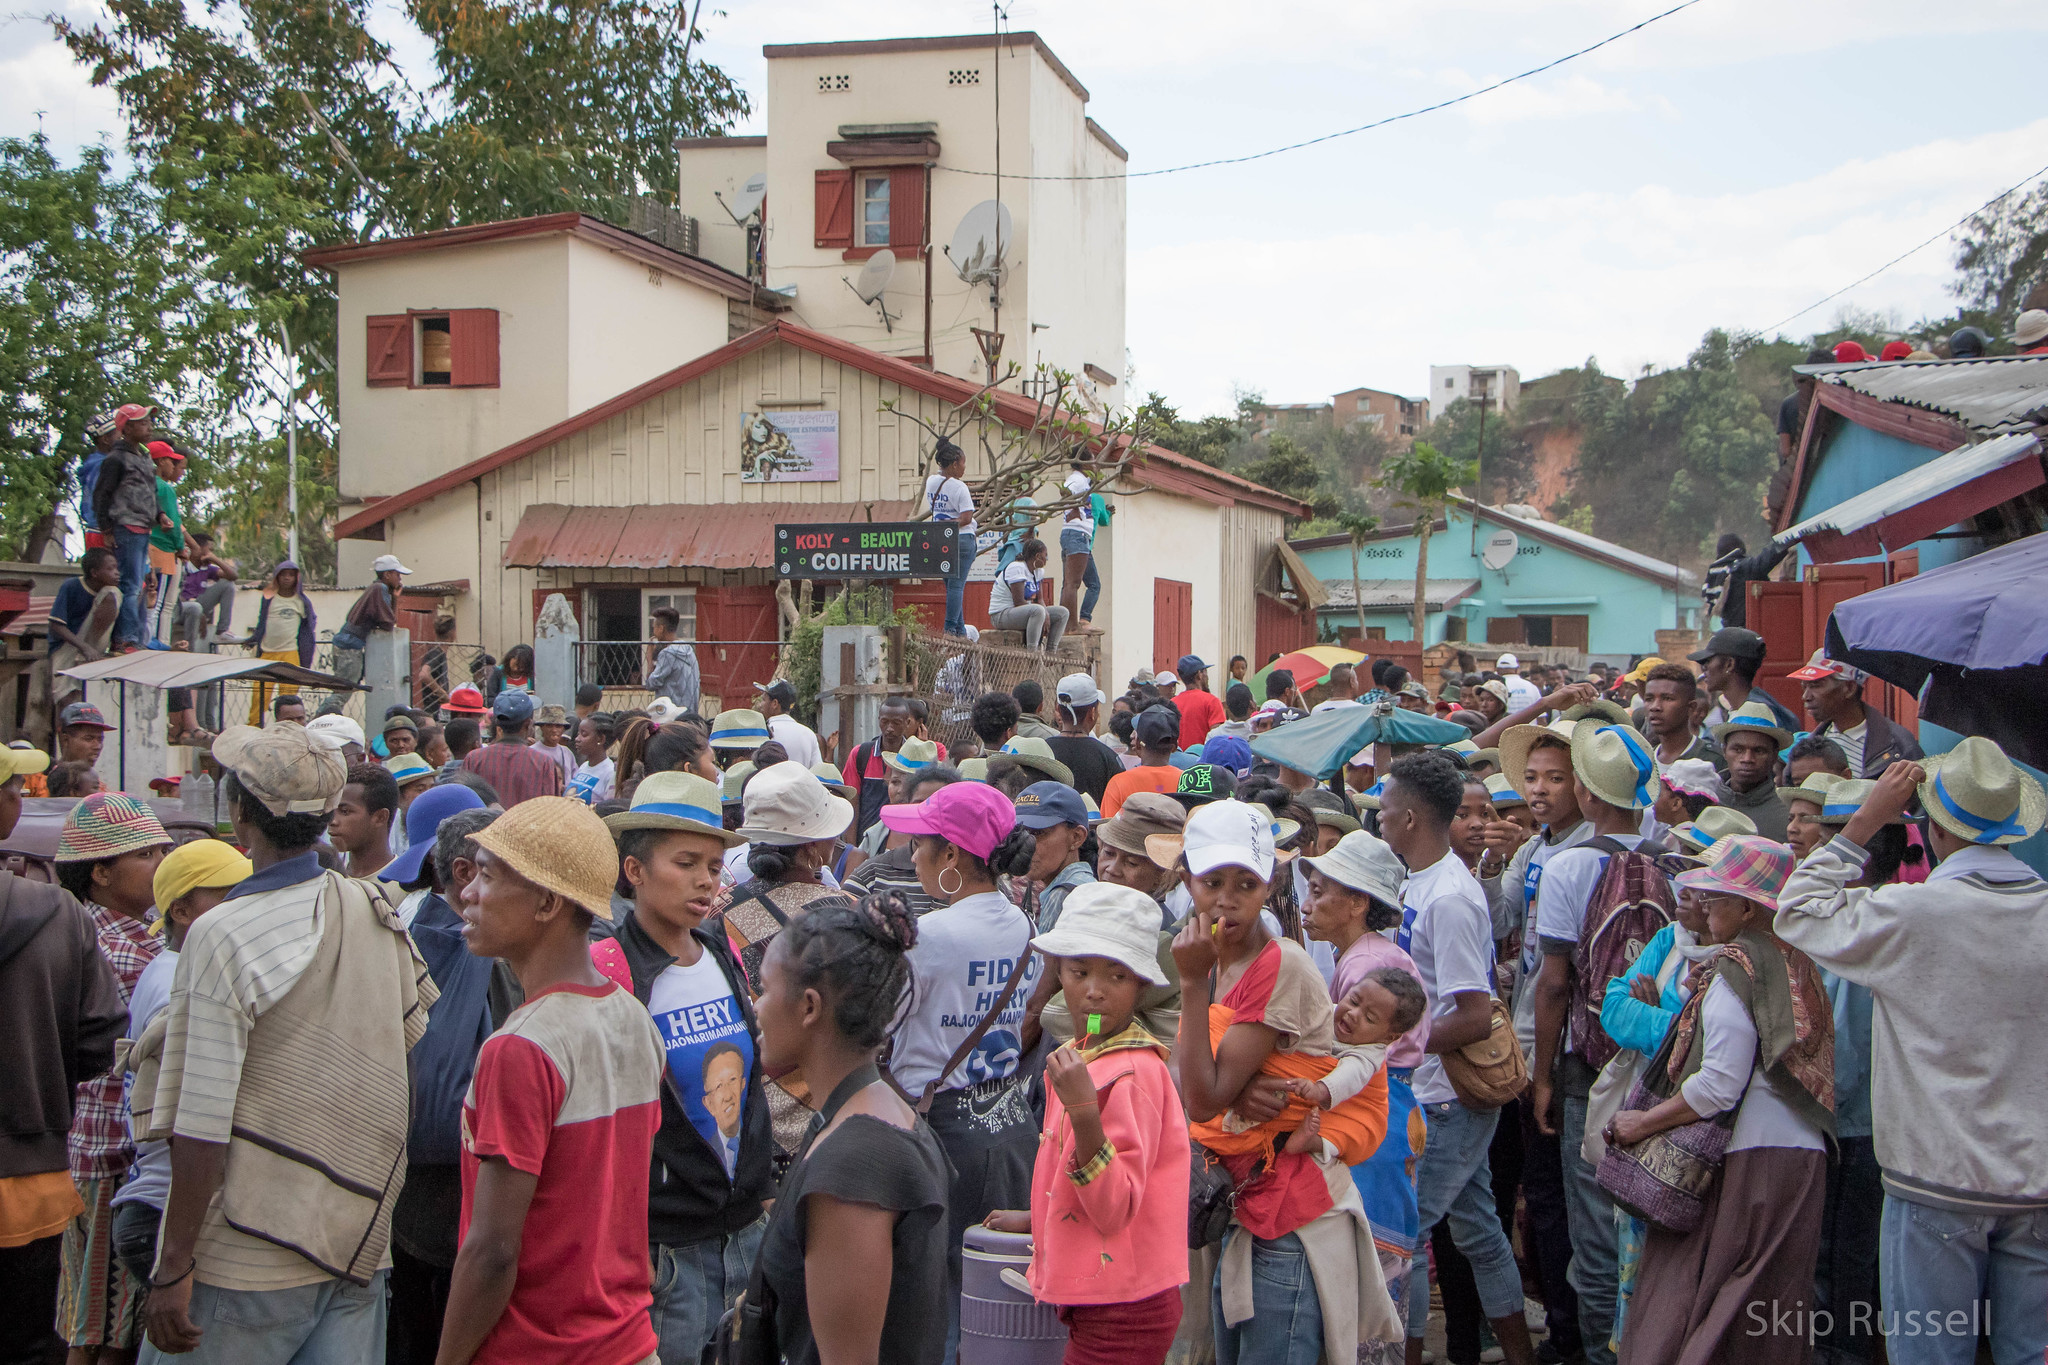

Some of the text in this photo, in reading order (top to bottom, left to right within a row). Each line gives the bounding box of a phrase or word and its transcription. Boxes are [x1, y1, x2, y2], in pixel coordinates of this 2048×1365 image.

[795, 533, 834, 549] KOLY
[861, 532, 913, 548] BEAUTY
[811, 552, 910, 571] COIFFURE
[667, 999, 733, 1037] HERY
